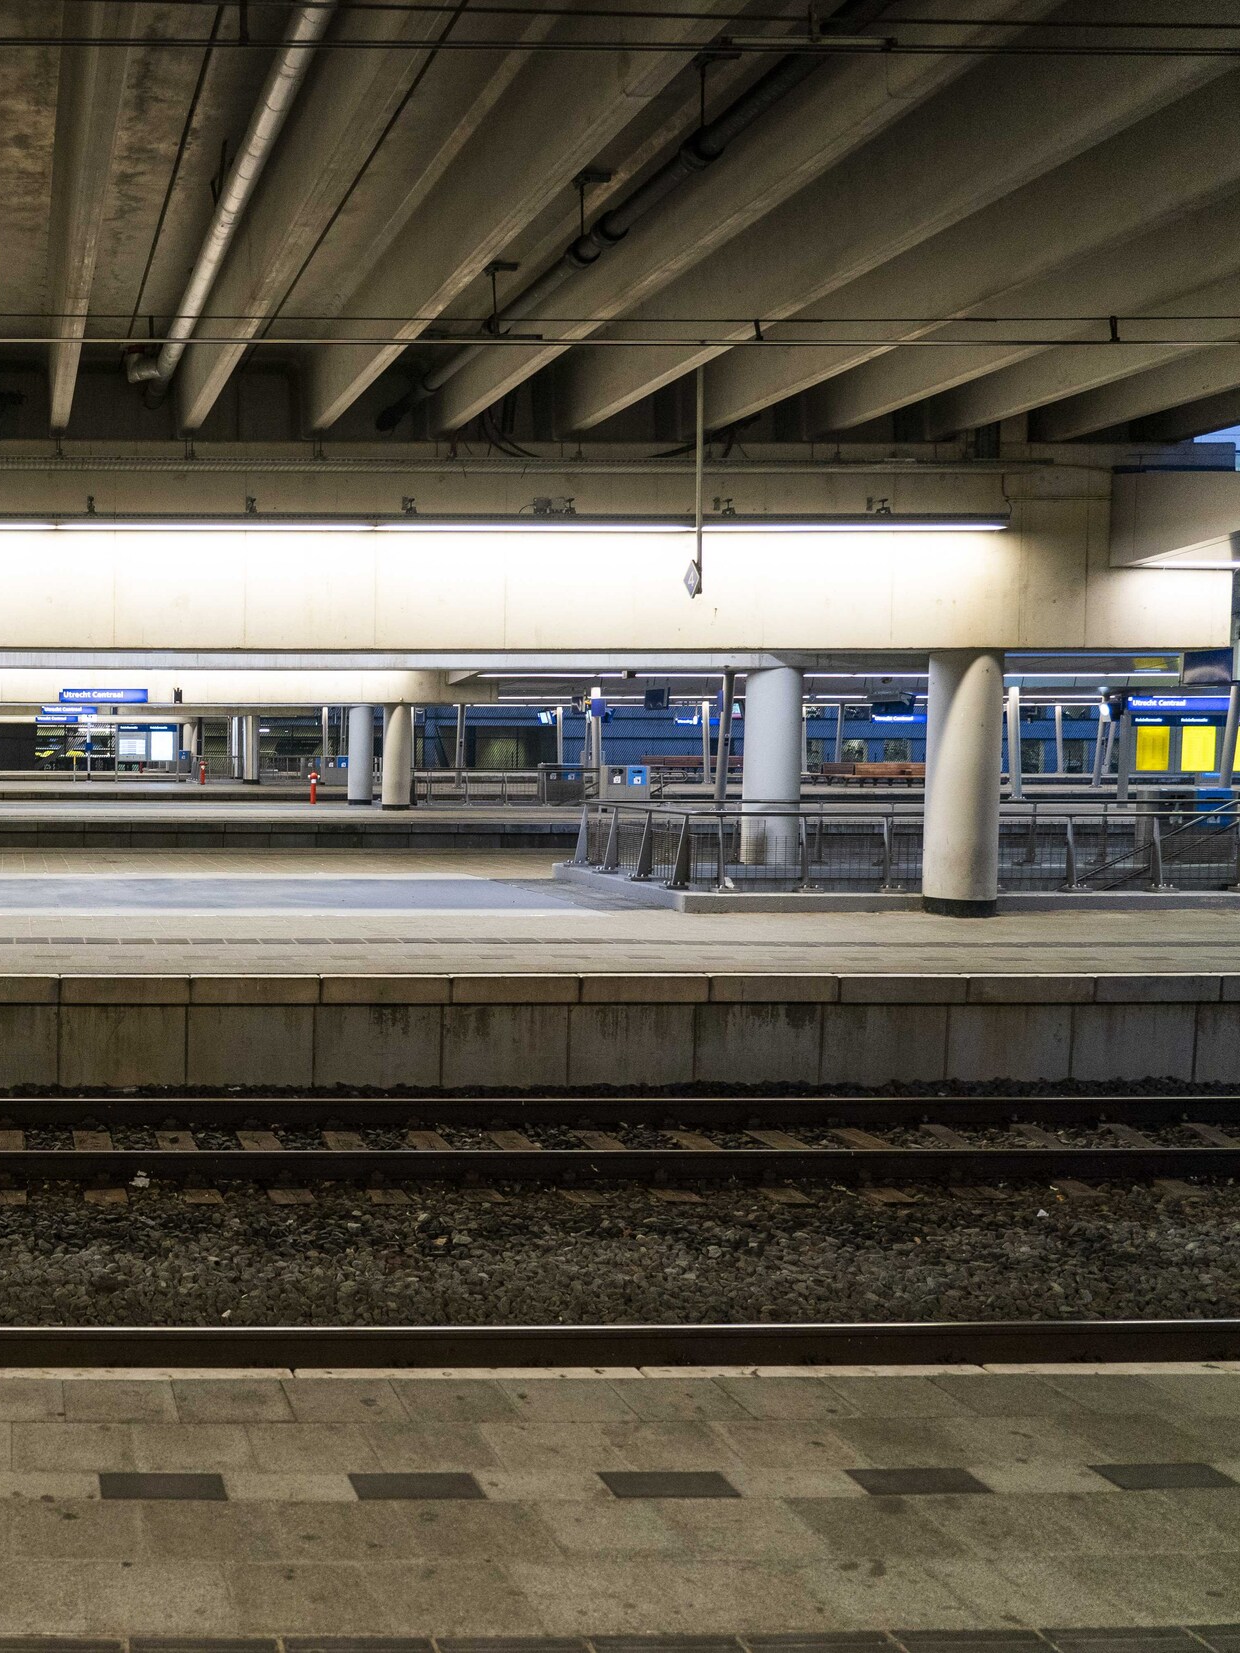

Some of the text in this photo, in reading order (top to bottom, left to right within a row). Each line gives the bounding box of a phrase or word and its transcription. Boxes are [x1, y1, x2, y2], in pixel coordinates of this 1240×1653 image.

[687, 570, 695, 587] 4
[63, 690, 124, 698] Utrecht Centraal
